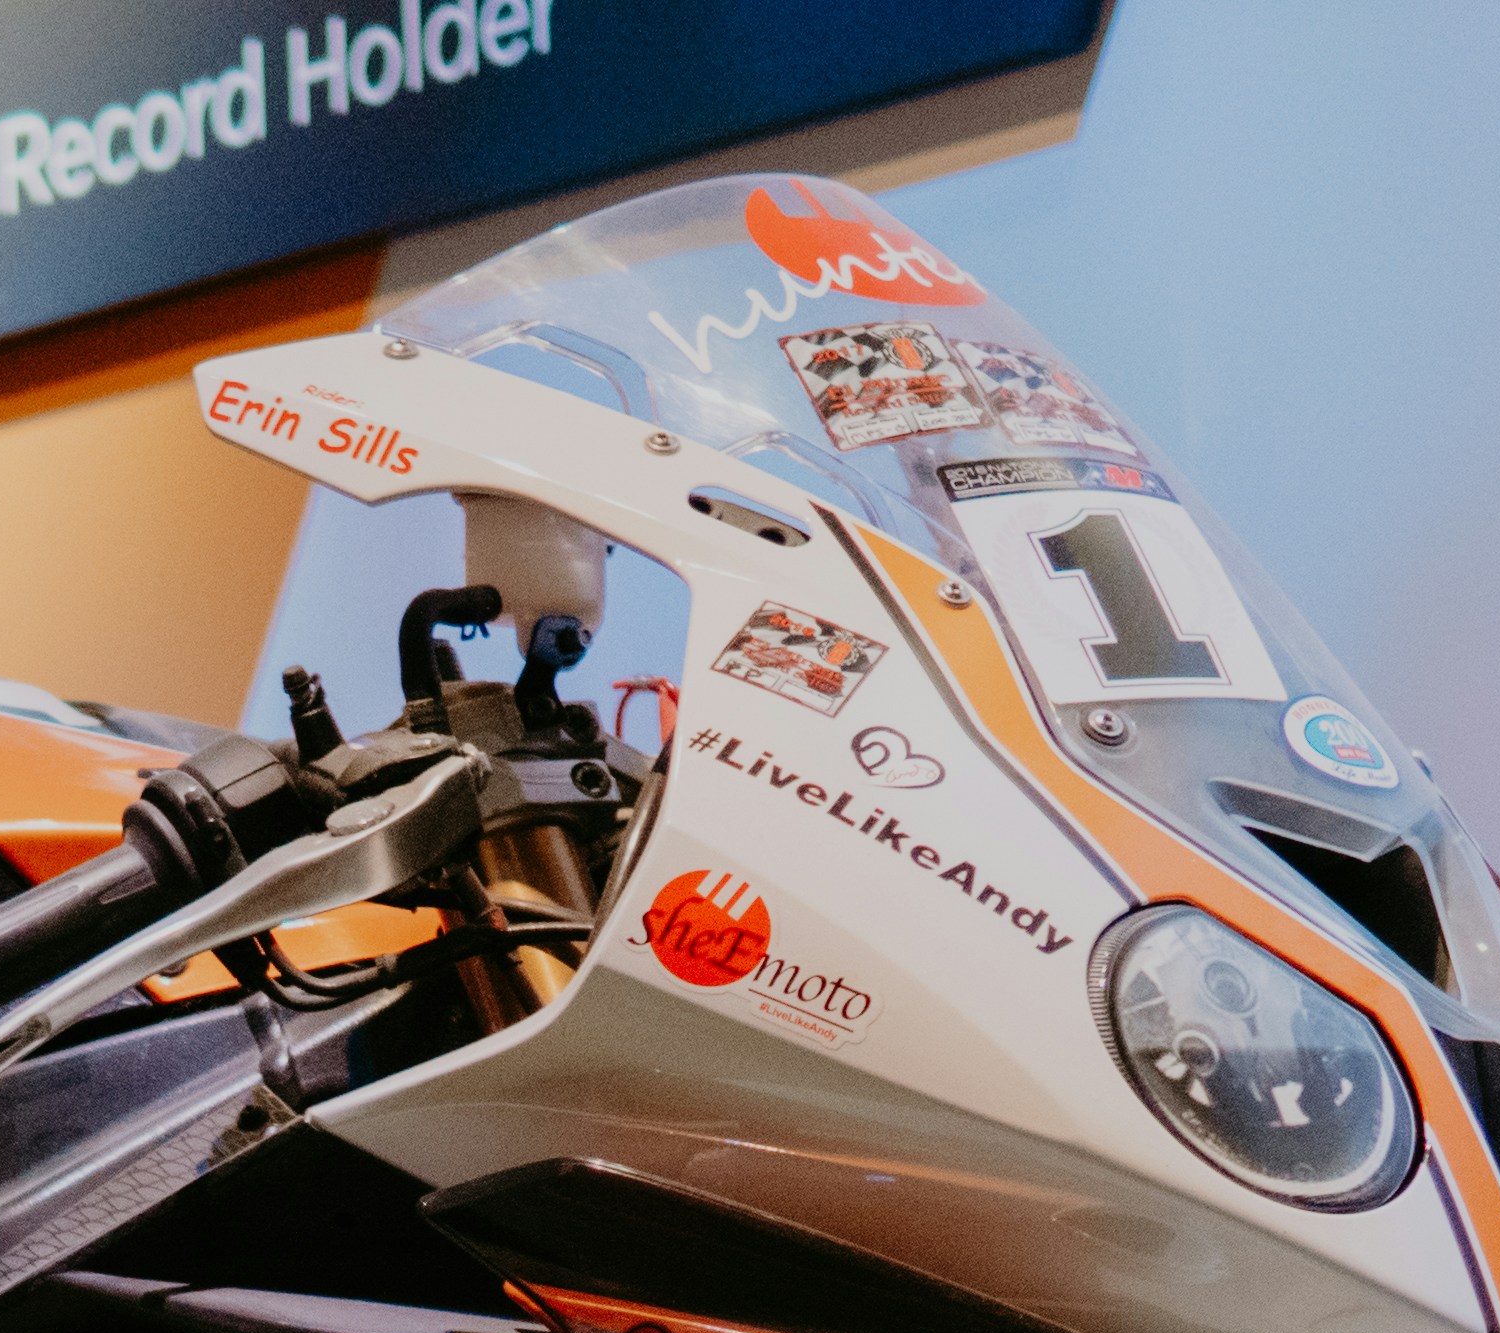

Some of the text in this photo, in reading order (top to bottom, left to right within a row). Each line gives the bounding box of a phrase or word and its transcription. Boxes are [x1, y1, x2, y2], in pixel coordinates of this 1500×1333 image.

[286, 0, 554, 127] Holder
[208, 380, 419, 475] Erin Sills
[948, 469, 1074, 491] CHAMPION
[1026, 506, 1231, 687] 1
[689, 725, 1075, 956] #LiveLikeAndy
[758, 1001, 839, 1042] #LiveLikeAndy
